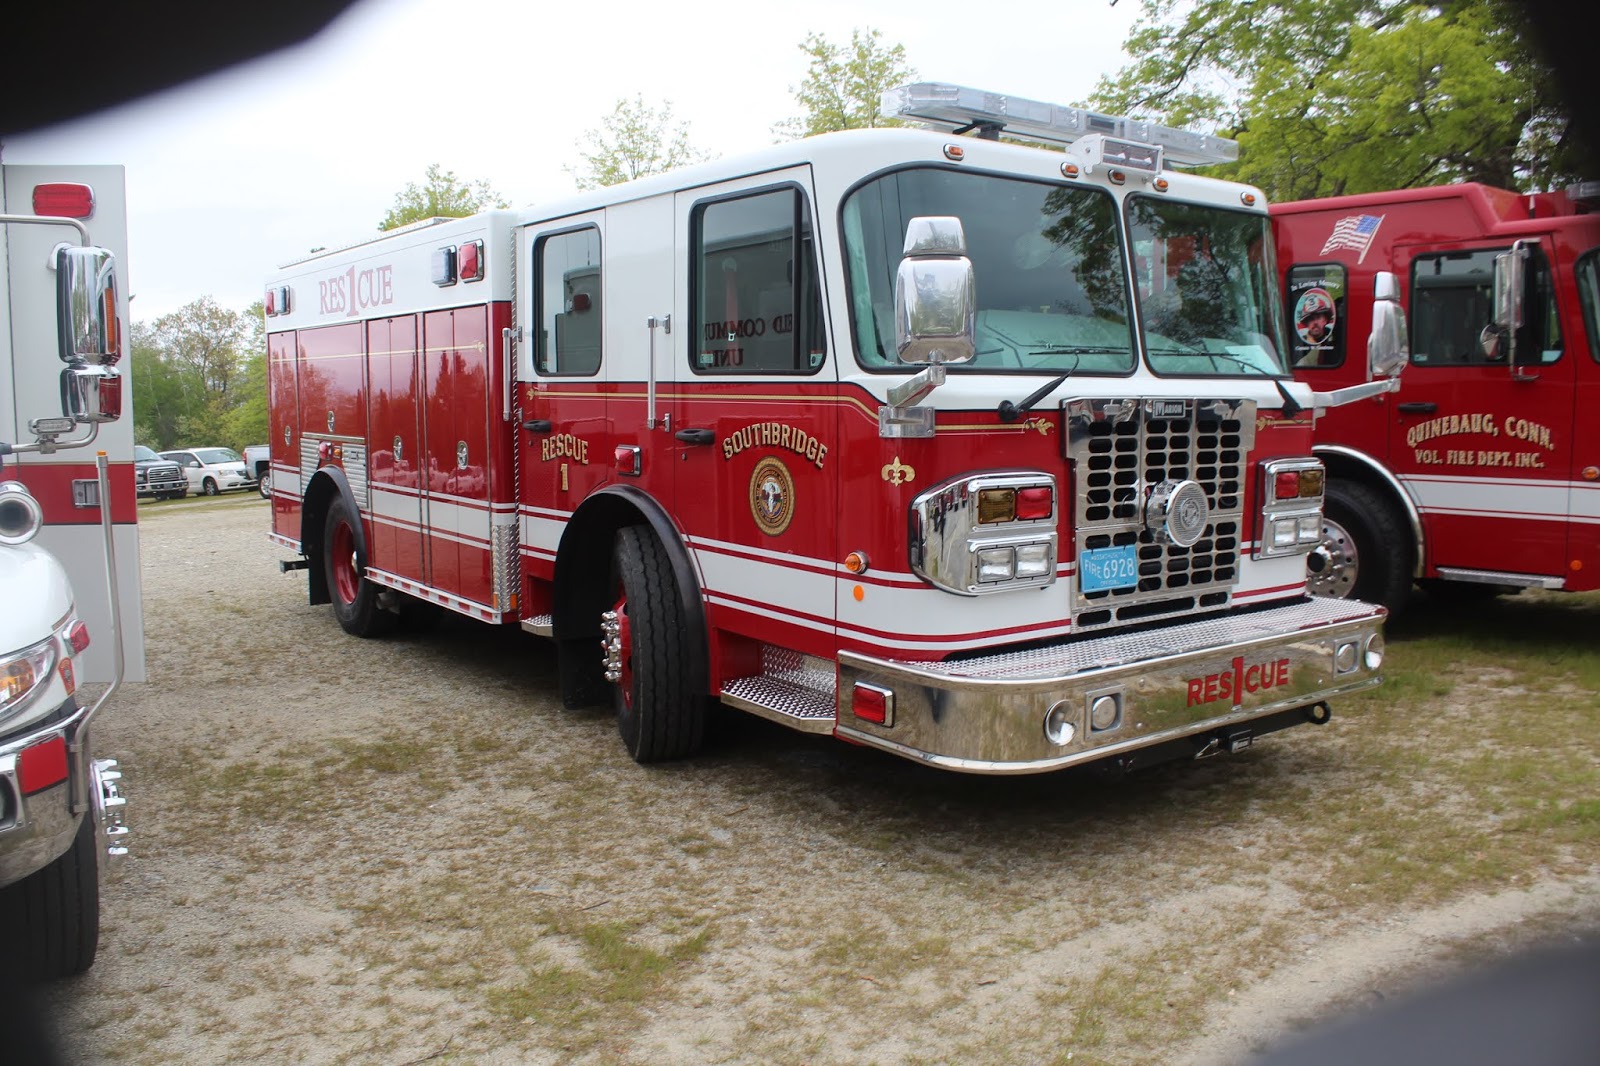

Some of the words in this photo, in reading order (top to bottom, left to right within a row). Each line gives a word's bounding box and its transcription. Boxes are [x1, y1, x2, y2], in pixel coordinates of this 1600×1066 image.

[1298, 280, 1318, 288] Loving
[1318, 279, 1341, 289] Memory
[722, 422, 828, 469] SOUTHBRIDGE
[1406, 413, 1499, 448] QUINEBAUG,
[1504, 416, 1554, 450] CONN.
[541, 433, 589, 465] RESCUE
[1414, 449, 1443, 464] VOL.
[1446, 450, 1475, 465] FIRE
[1477, 451, 1513, 467] DEPT.
[1514, 452, 1545, 468] INC.
[560, 463, 569, 491] 1
[1103, 558, 1135, 579] 6928
